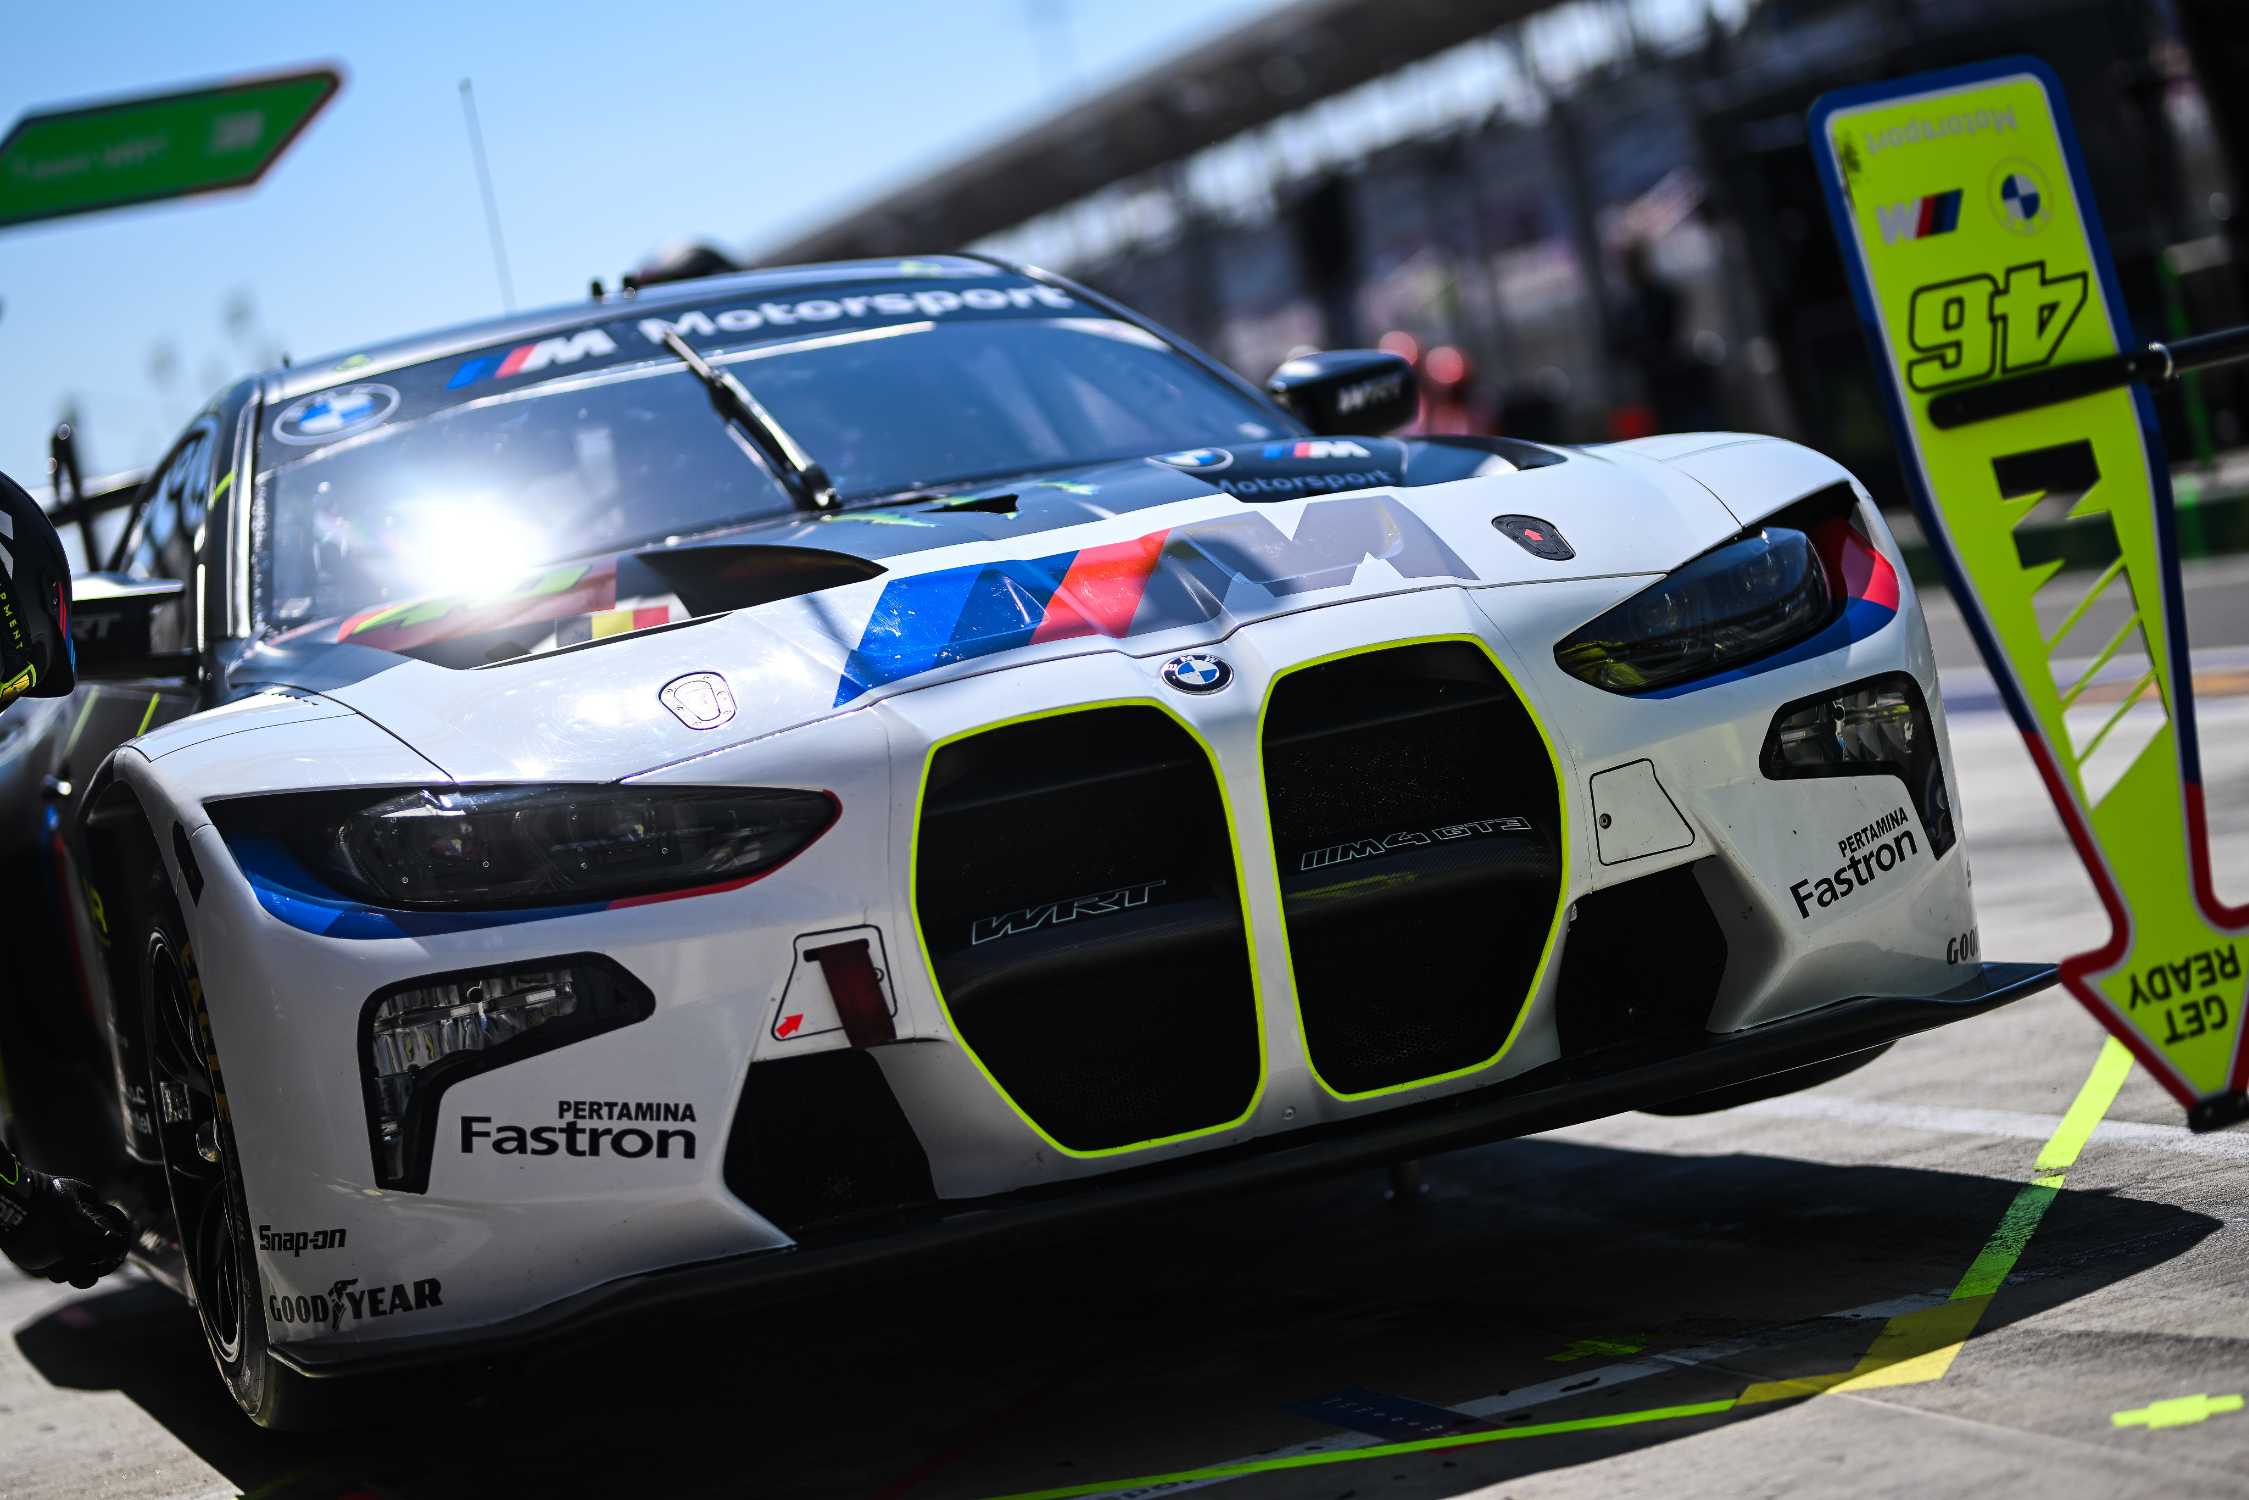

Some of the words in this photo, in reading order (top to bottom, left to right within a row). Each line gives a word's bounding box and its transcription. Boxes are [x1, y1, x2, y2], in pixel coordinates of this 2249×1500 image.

[1866, 105, 2018, 156] Motorsport
[638, 284, 1075, 343] Motorsport
[1907, 260, 2089, 394] 46
[1431, 816, 1532, 841] GT3
[1837, 807, 1909, 858] PERTAMINA
[1789, 829, 1918, 920] Fastron
[971, 879, 1168, 946] WRT
[2127, 943, 2242, 1011] READY
[2163, 995, 2229, 1047] GET
[558, 1100, 697, 1123] PERTAMINA
[461, 1116, 696, 1159] Fastron
[258, 1225, 347, 1258] Snap-on
